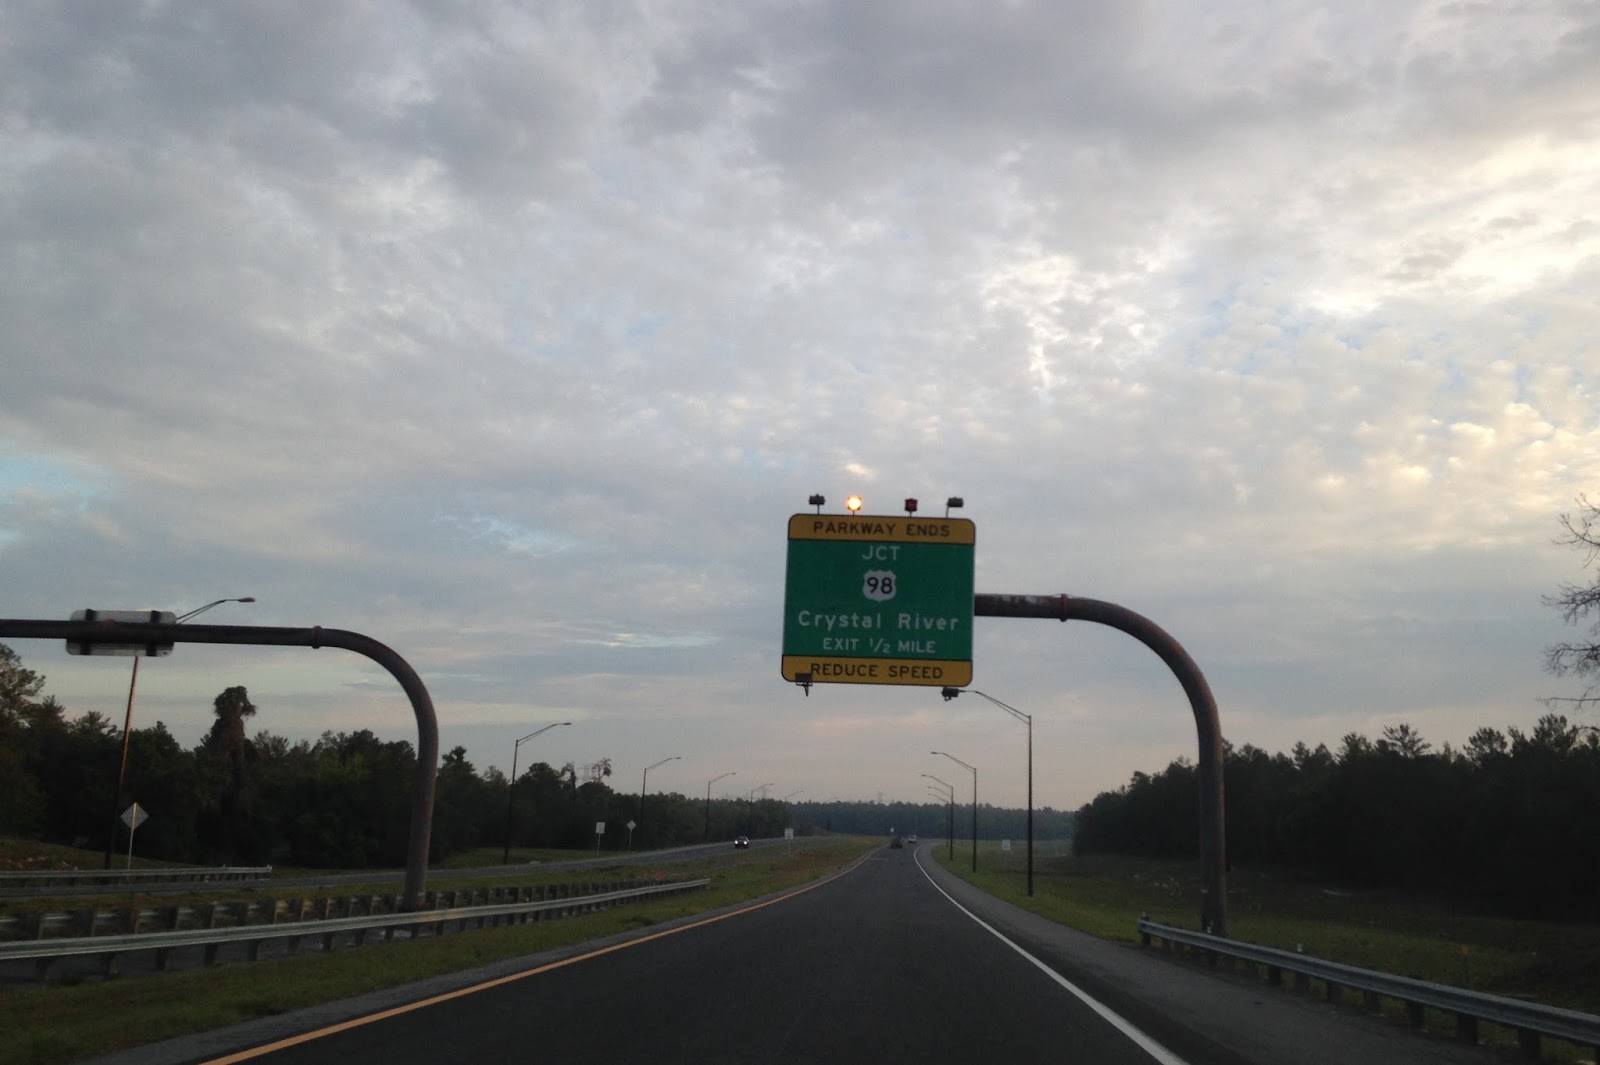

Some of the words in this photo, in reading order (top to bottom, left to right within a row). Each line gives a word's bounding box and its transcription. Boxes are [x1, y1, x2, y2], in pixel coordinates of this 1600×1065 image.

[813, 521, 896, 534] PARKWAY
[906, 524, 950, 537] ENDS
[862, 546, 900, 560] JCT
[867, 577, 893, 594] 98
[798, 611, 881, 631] Crystal
[898, 614, 959, 631] River
[823, 638, 859, 650] EXIT
[898, 641, 936, 653] MILE
[811, 663, 878, 677] REDUCE
[889, 666, 943, 679] SPEED
